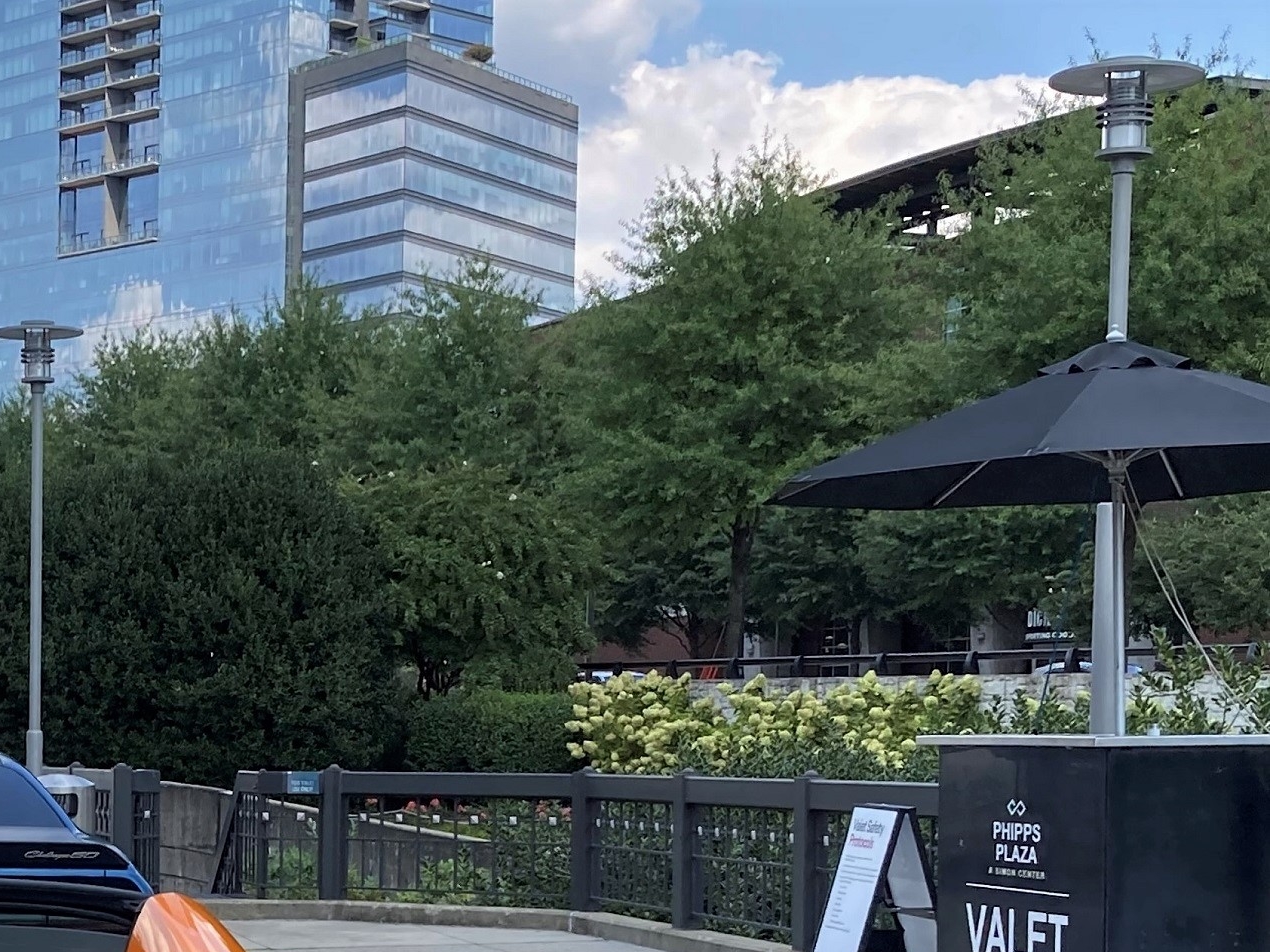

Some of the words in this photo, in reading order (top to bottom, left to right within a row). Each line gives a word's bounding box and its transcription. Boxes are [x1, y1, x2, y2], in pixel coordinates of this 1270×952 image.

[992, 821, 1042, 843] PHIPPS
[995, 843, 1038, 865] PLAZA
[995, 867, 1016, 876] SIMON
[1017, 869, 1046, 880] CENTER
